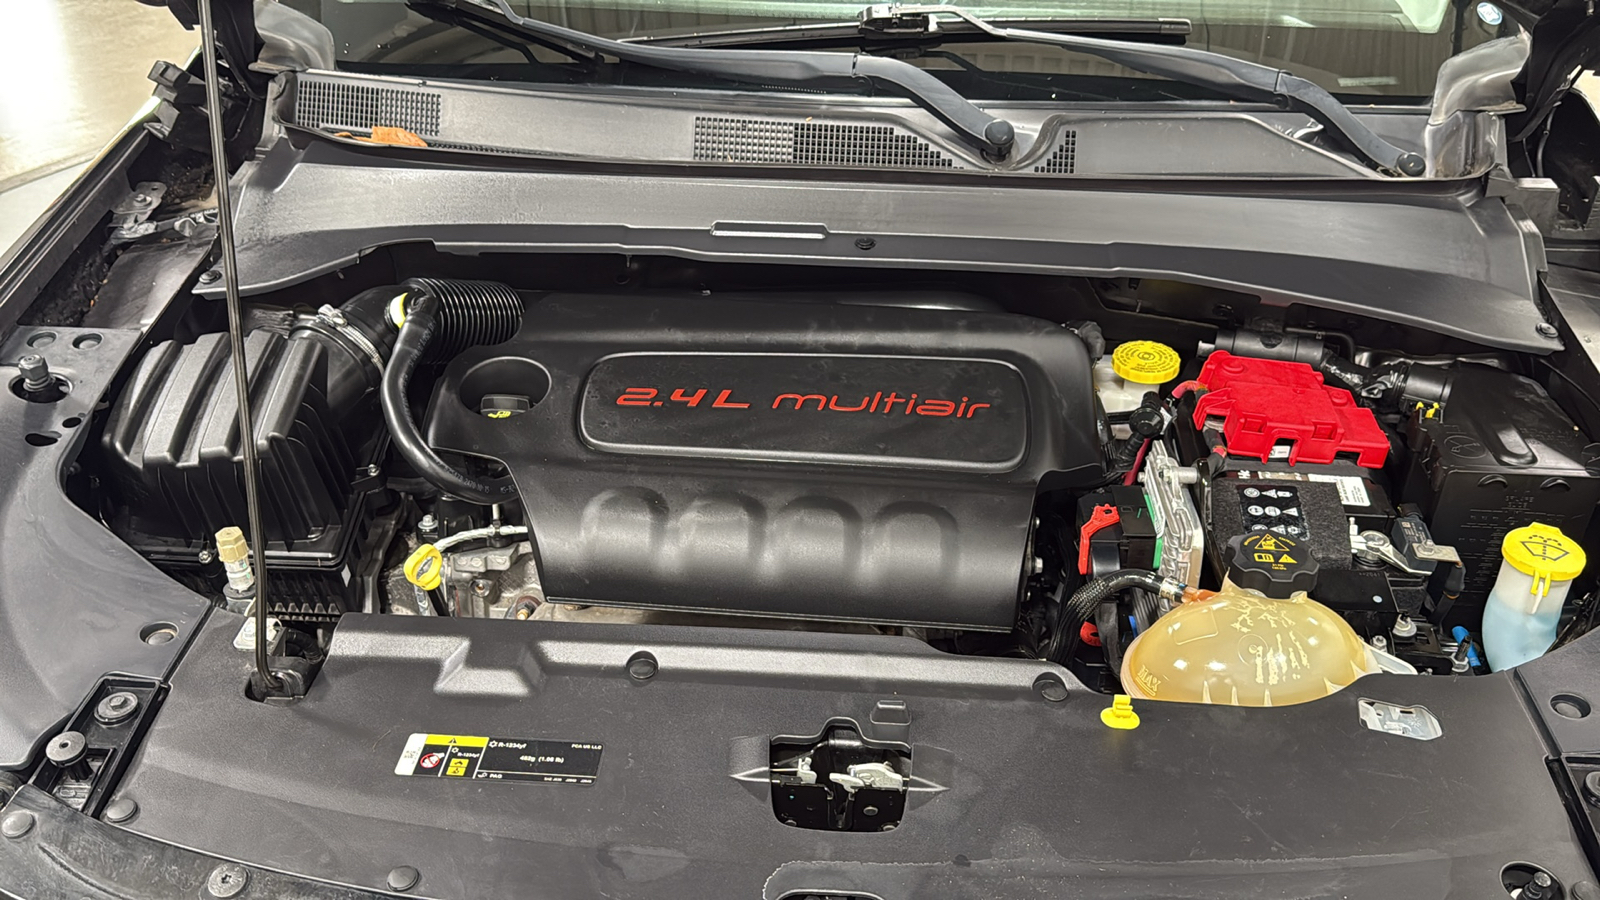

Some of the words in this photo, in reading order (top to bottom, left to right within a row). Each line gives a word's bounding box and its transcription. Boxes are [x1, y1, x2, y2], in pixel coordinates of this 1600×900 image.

[616, 387, 751, 408] 2.4L
[772, 391, 990, 418] multiair
[1137, 664, 1161, 692] MAX
[497, 742, 527, 750] R-1234yf
